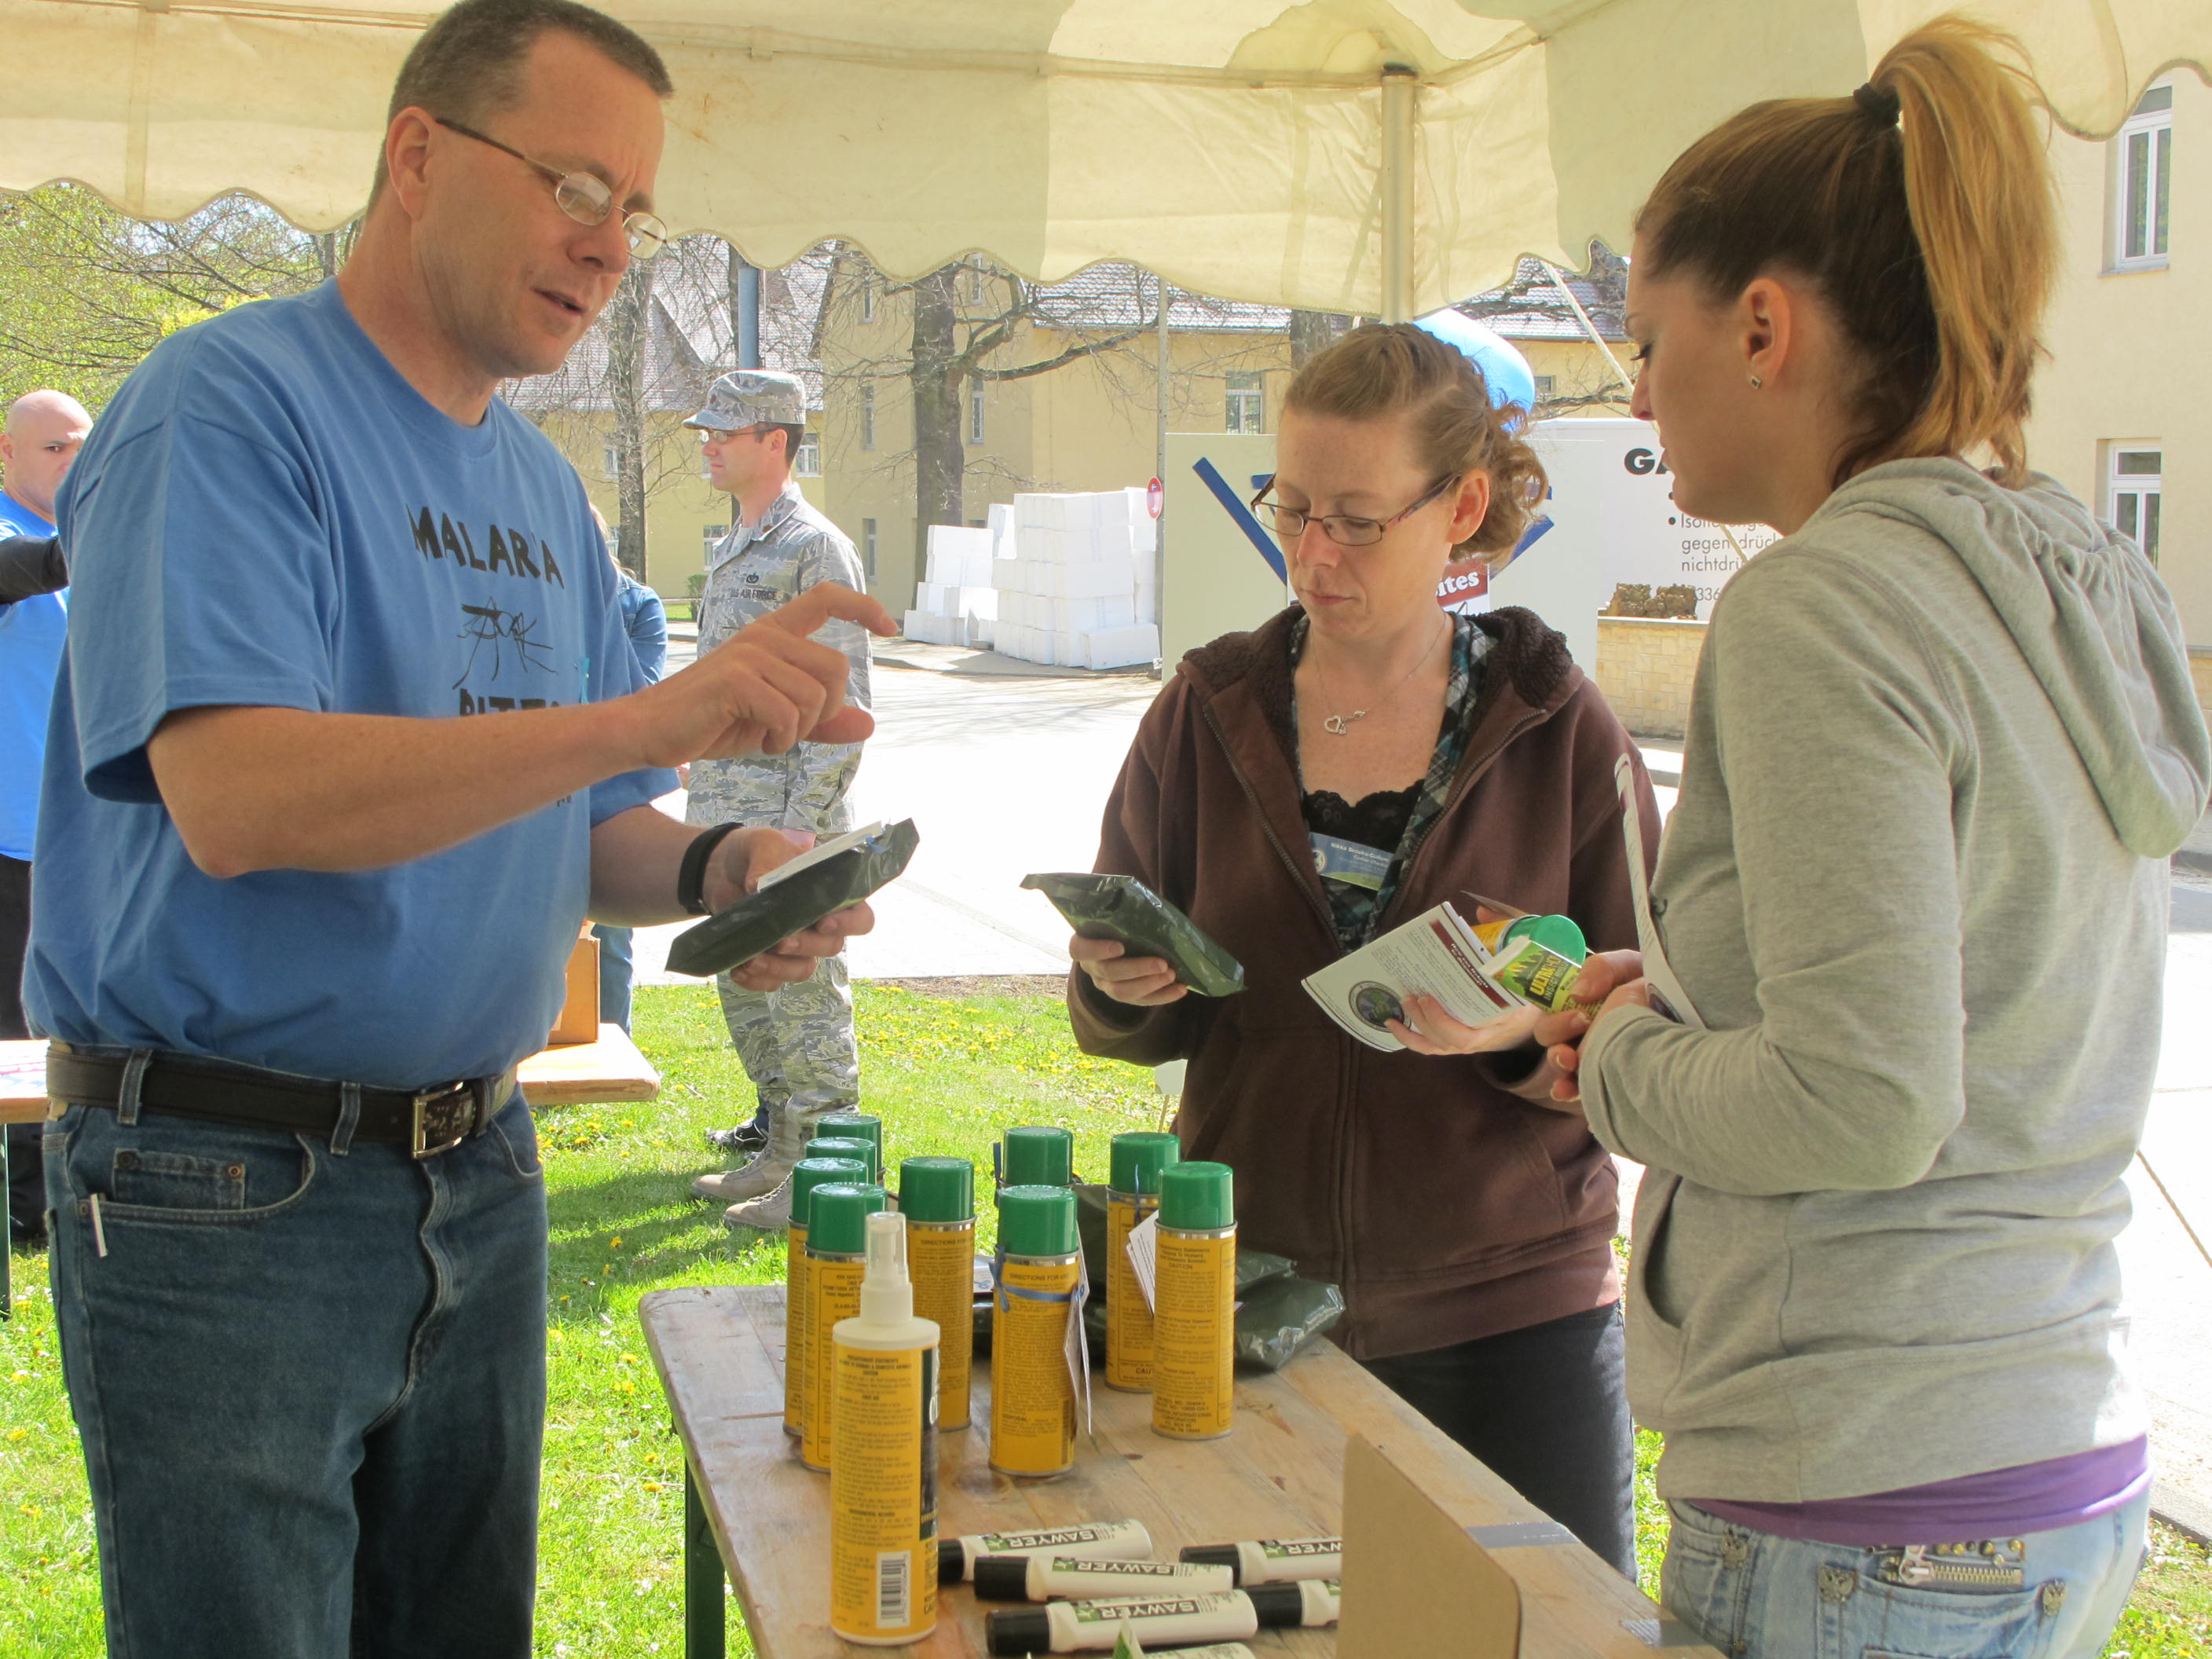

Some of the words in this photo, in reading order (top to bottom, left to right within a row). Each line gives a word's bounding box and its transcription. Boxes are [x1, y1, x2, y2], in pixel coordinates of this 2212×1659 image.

[406, 504, 565, 589] MALARA
[1680, 538, 1730, 555] gegen
[1435, 572, 1480, 597] ites
[740, 588, 752, 599] AIR
[753, 589, 778, 600] FORCE
[1007, 1530, 1094, 1548] SAWYER
[1287, 1541, 1342, 1556] WYER
[1077, 1561, 1174, 1576] SAWYER
[1101, 1600, 1195, 1619] SAWYER
